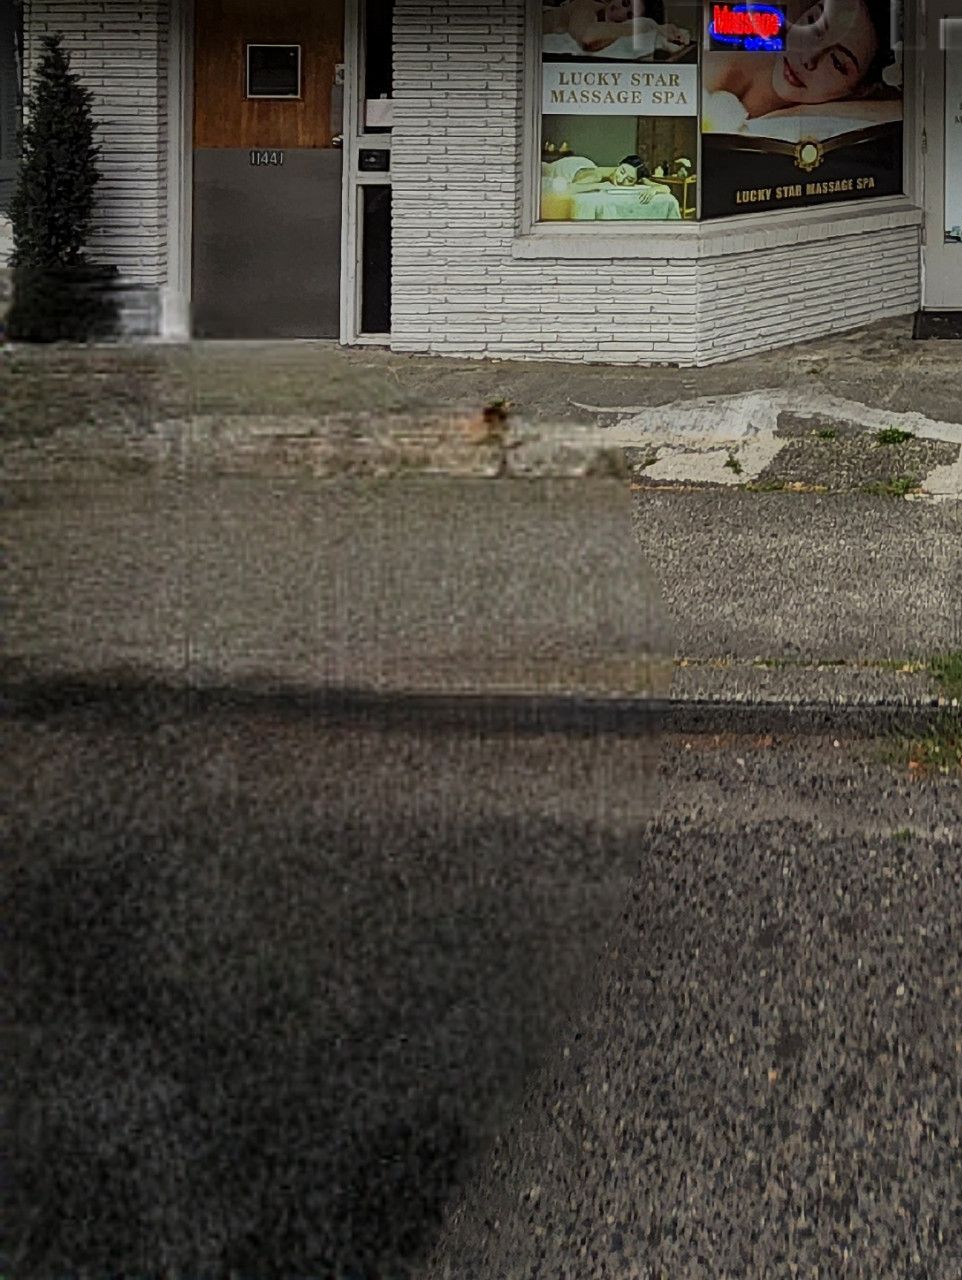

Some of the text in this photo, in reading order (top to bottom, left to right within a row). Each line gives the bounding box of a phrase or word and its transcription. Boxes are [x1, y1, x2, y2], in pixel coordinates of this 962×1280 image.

[558, 71, 680, 87] LUCKY STAR
[550, 89, 688, 105] MASSAGE SPA
[250, 150, 284, 166] 11441
[735, 176, 876, 204] LUCKY STAR MASSAGE SPA
